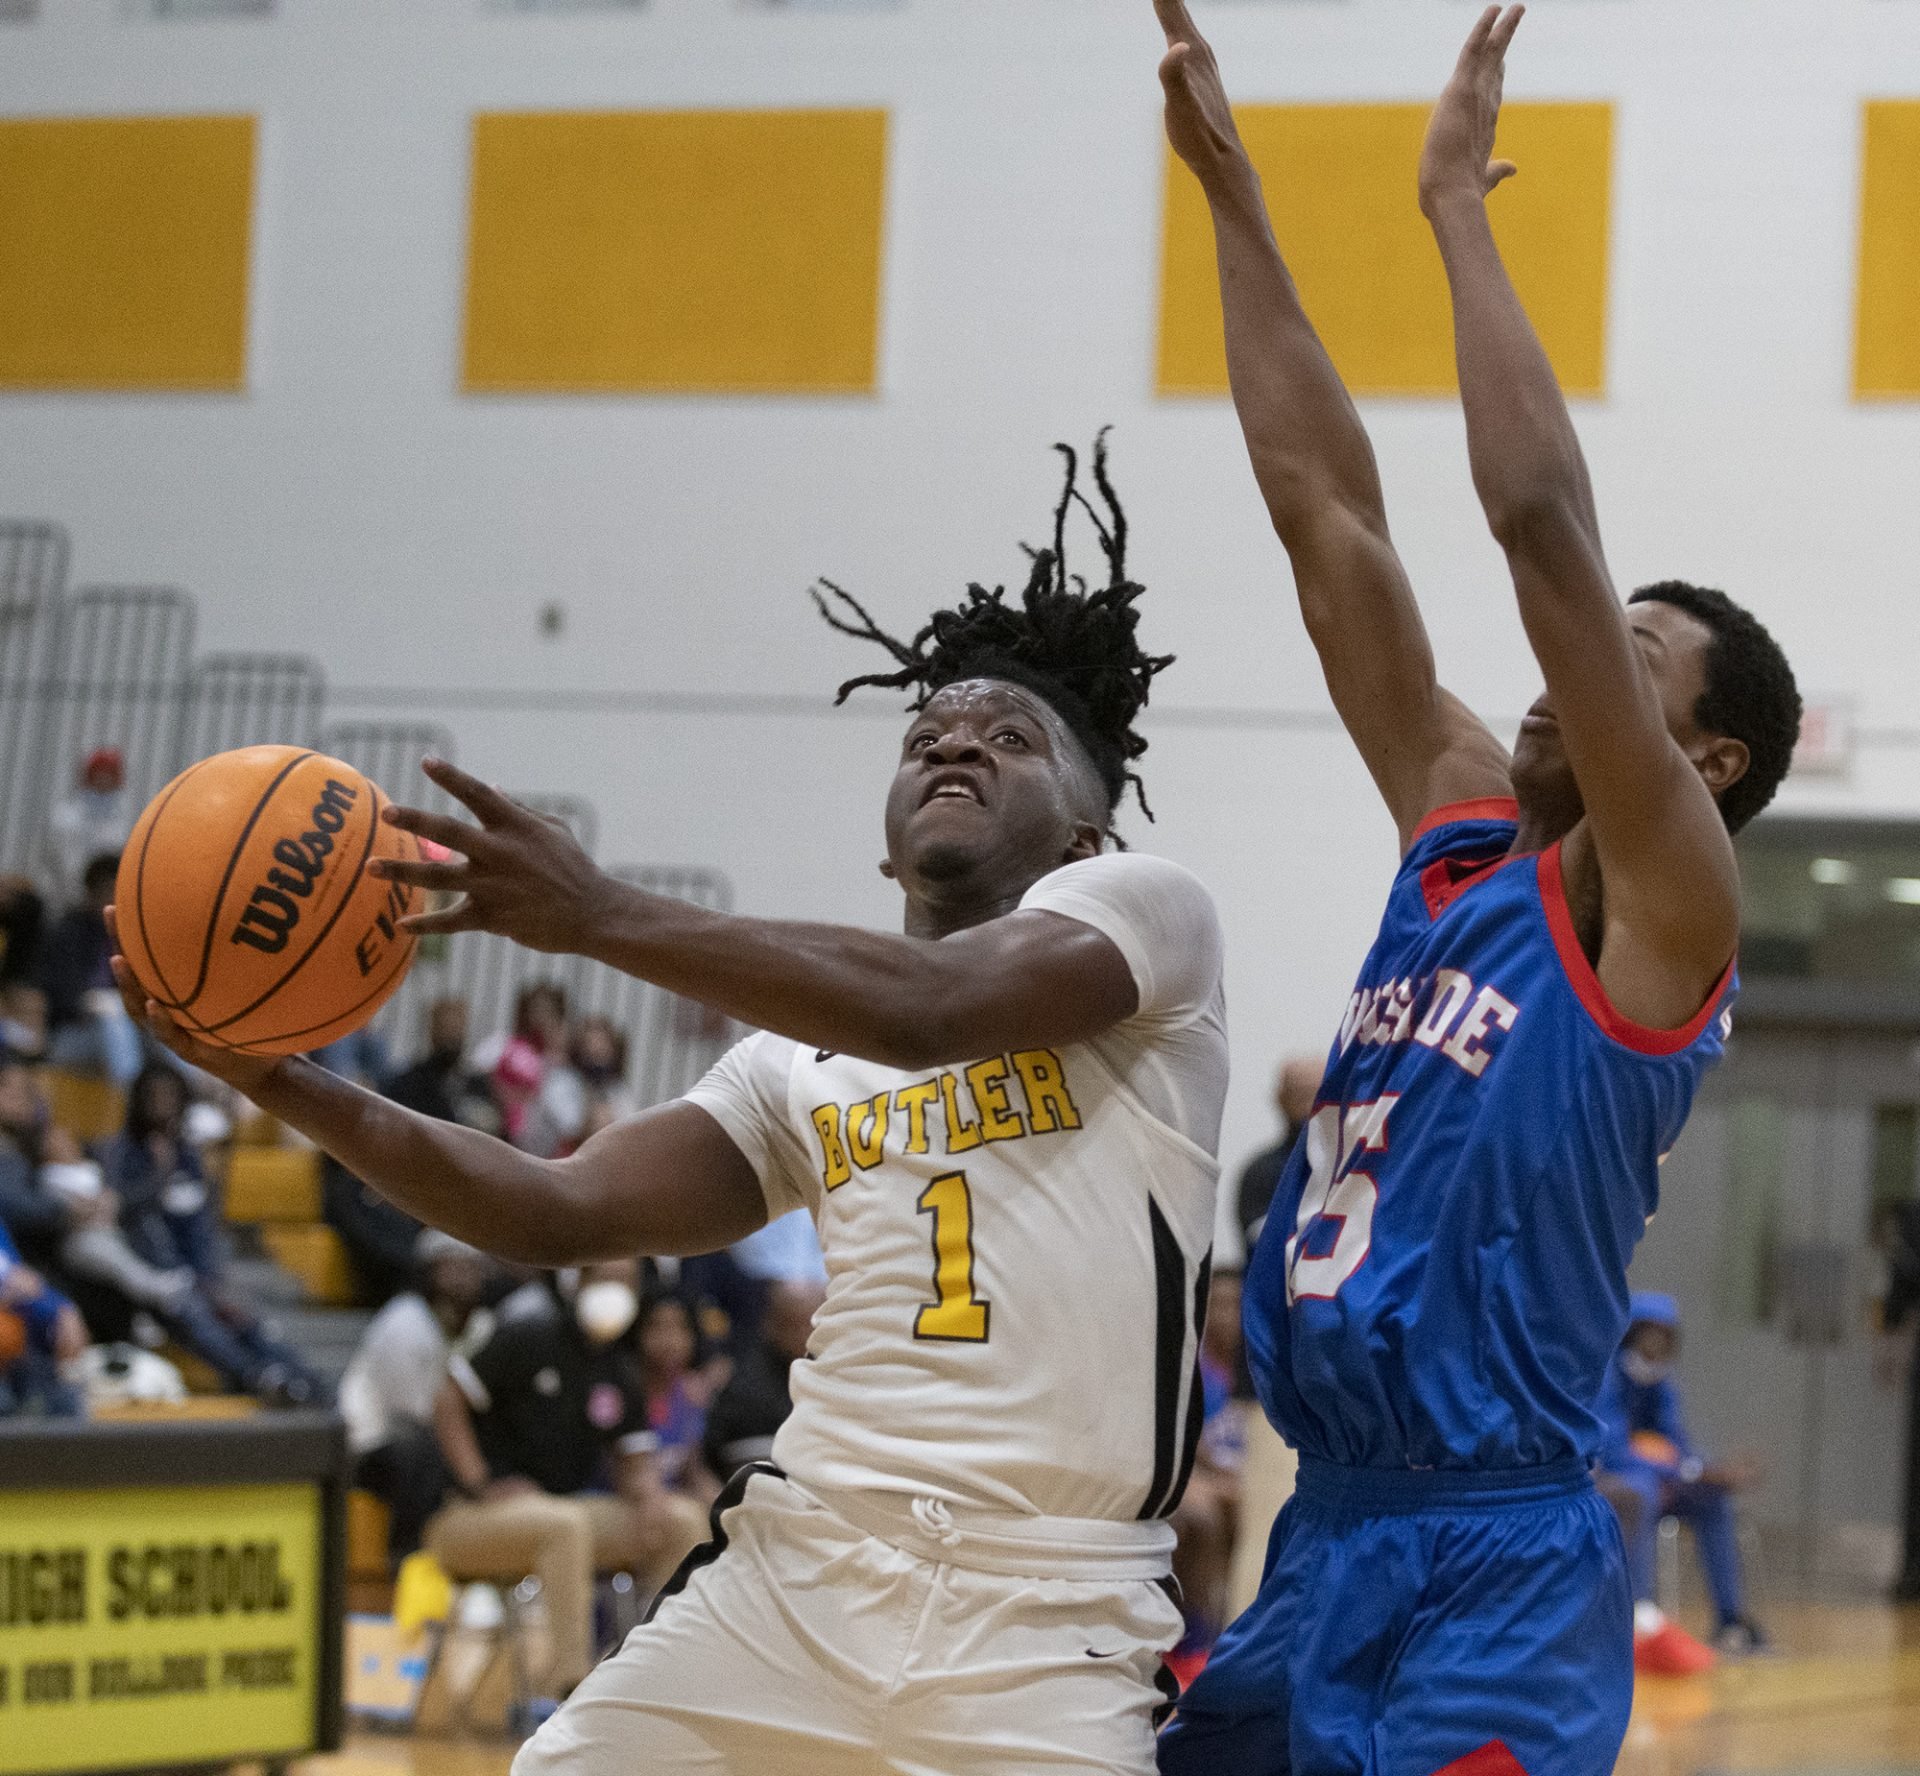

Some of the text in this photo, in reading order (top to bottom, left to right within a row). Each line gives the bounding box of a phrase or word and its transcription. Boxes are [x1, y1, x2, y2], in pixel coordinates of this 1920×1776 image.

[231, 779, 357, 954] Wilson
[811, 1048, 1083, 1192] BUTLER
[913, 1170, 990, 1343] 1
[0, 1542, 291, 1624] IGH SCHOOL
